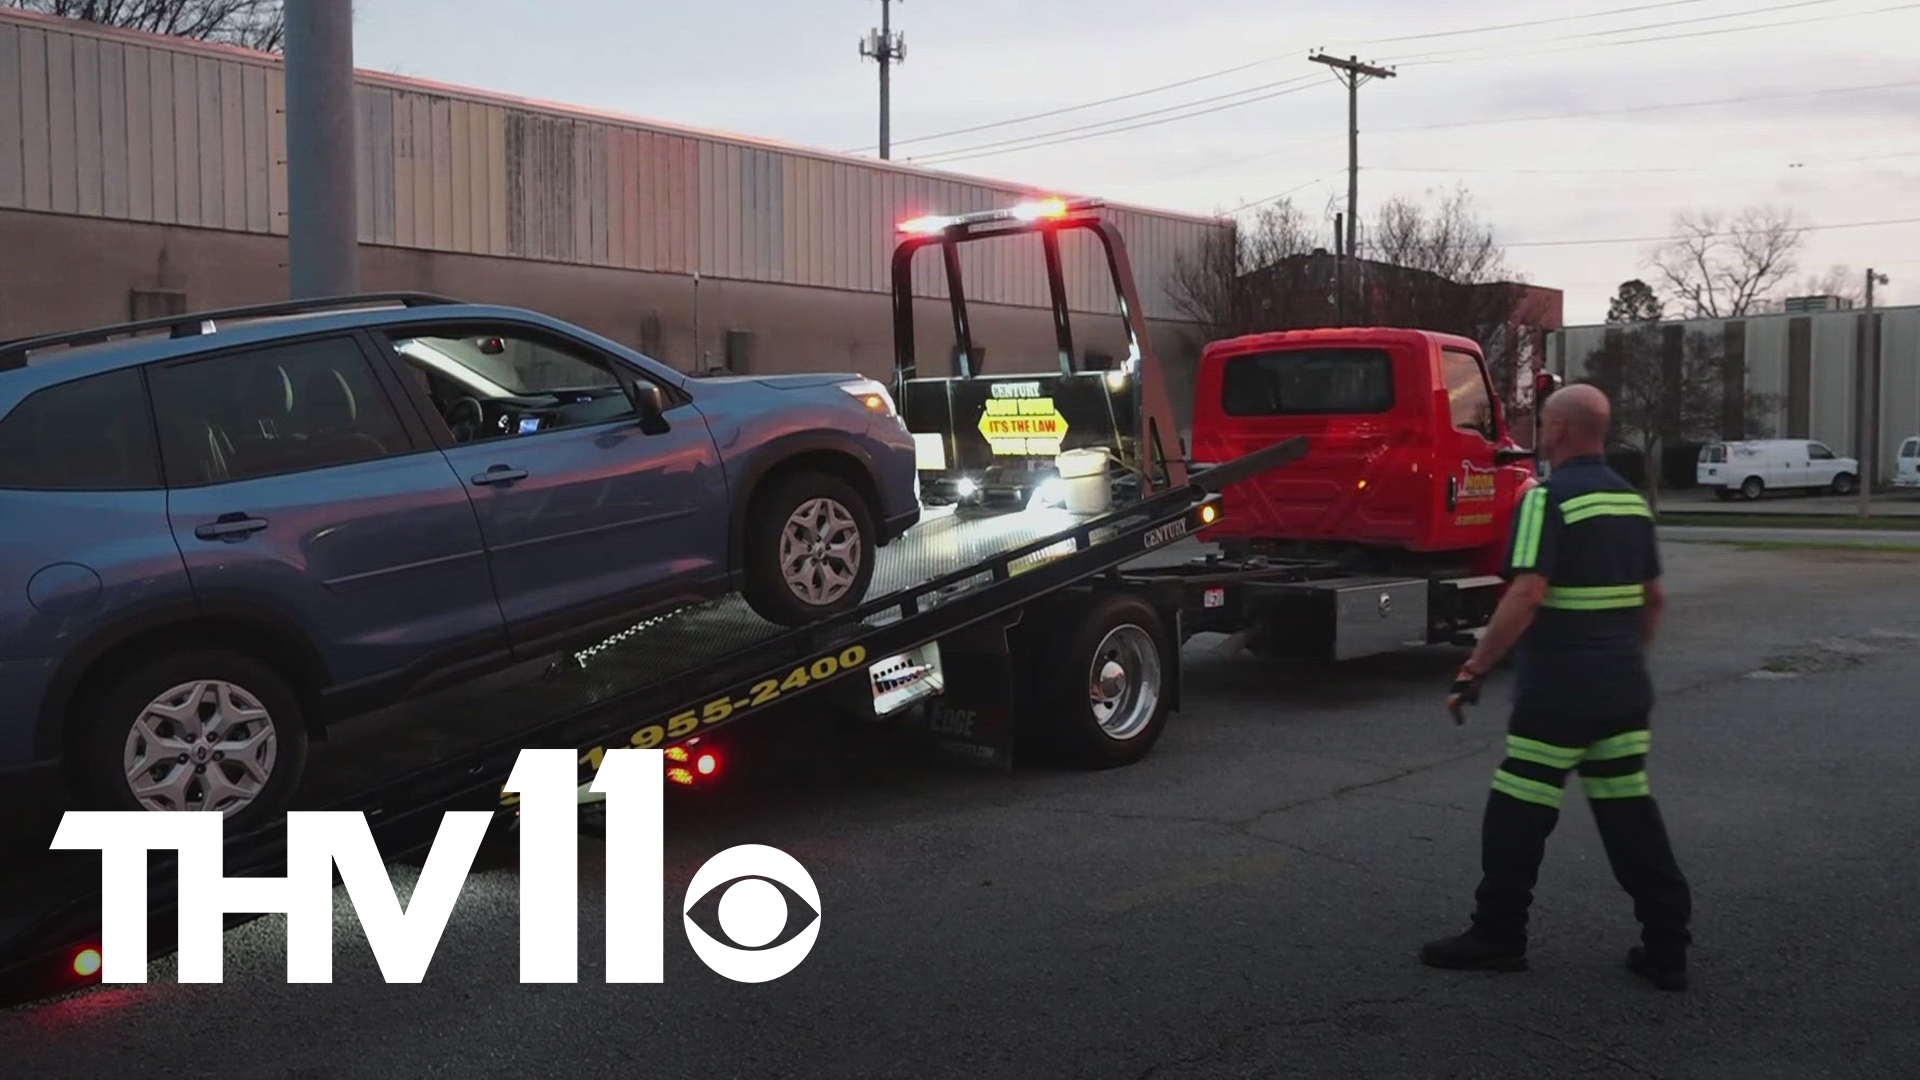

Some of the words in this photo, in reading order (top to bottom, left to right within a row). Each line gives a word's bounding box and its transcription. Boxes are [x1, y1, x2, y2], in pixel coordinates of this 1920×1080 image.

[991, 382, 1040, 398] CENTURY
[989, 420, 1009, 433] IT'S
[1010, 420, 1030, 433] THE
[1033, 419, 1056, 432] LAW
[1143, 517, 1187, 548] CENTURY
[500, 645, 866, 806] 1955-2400
